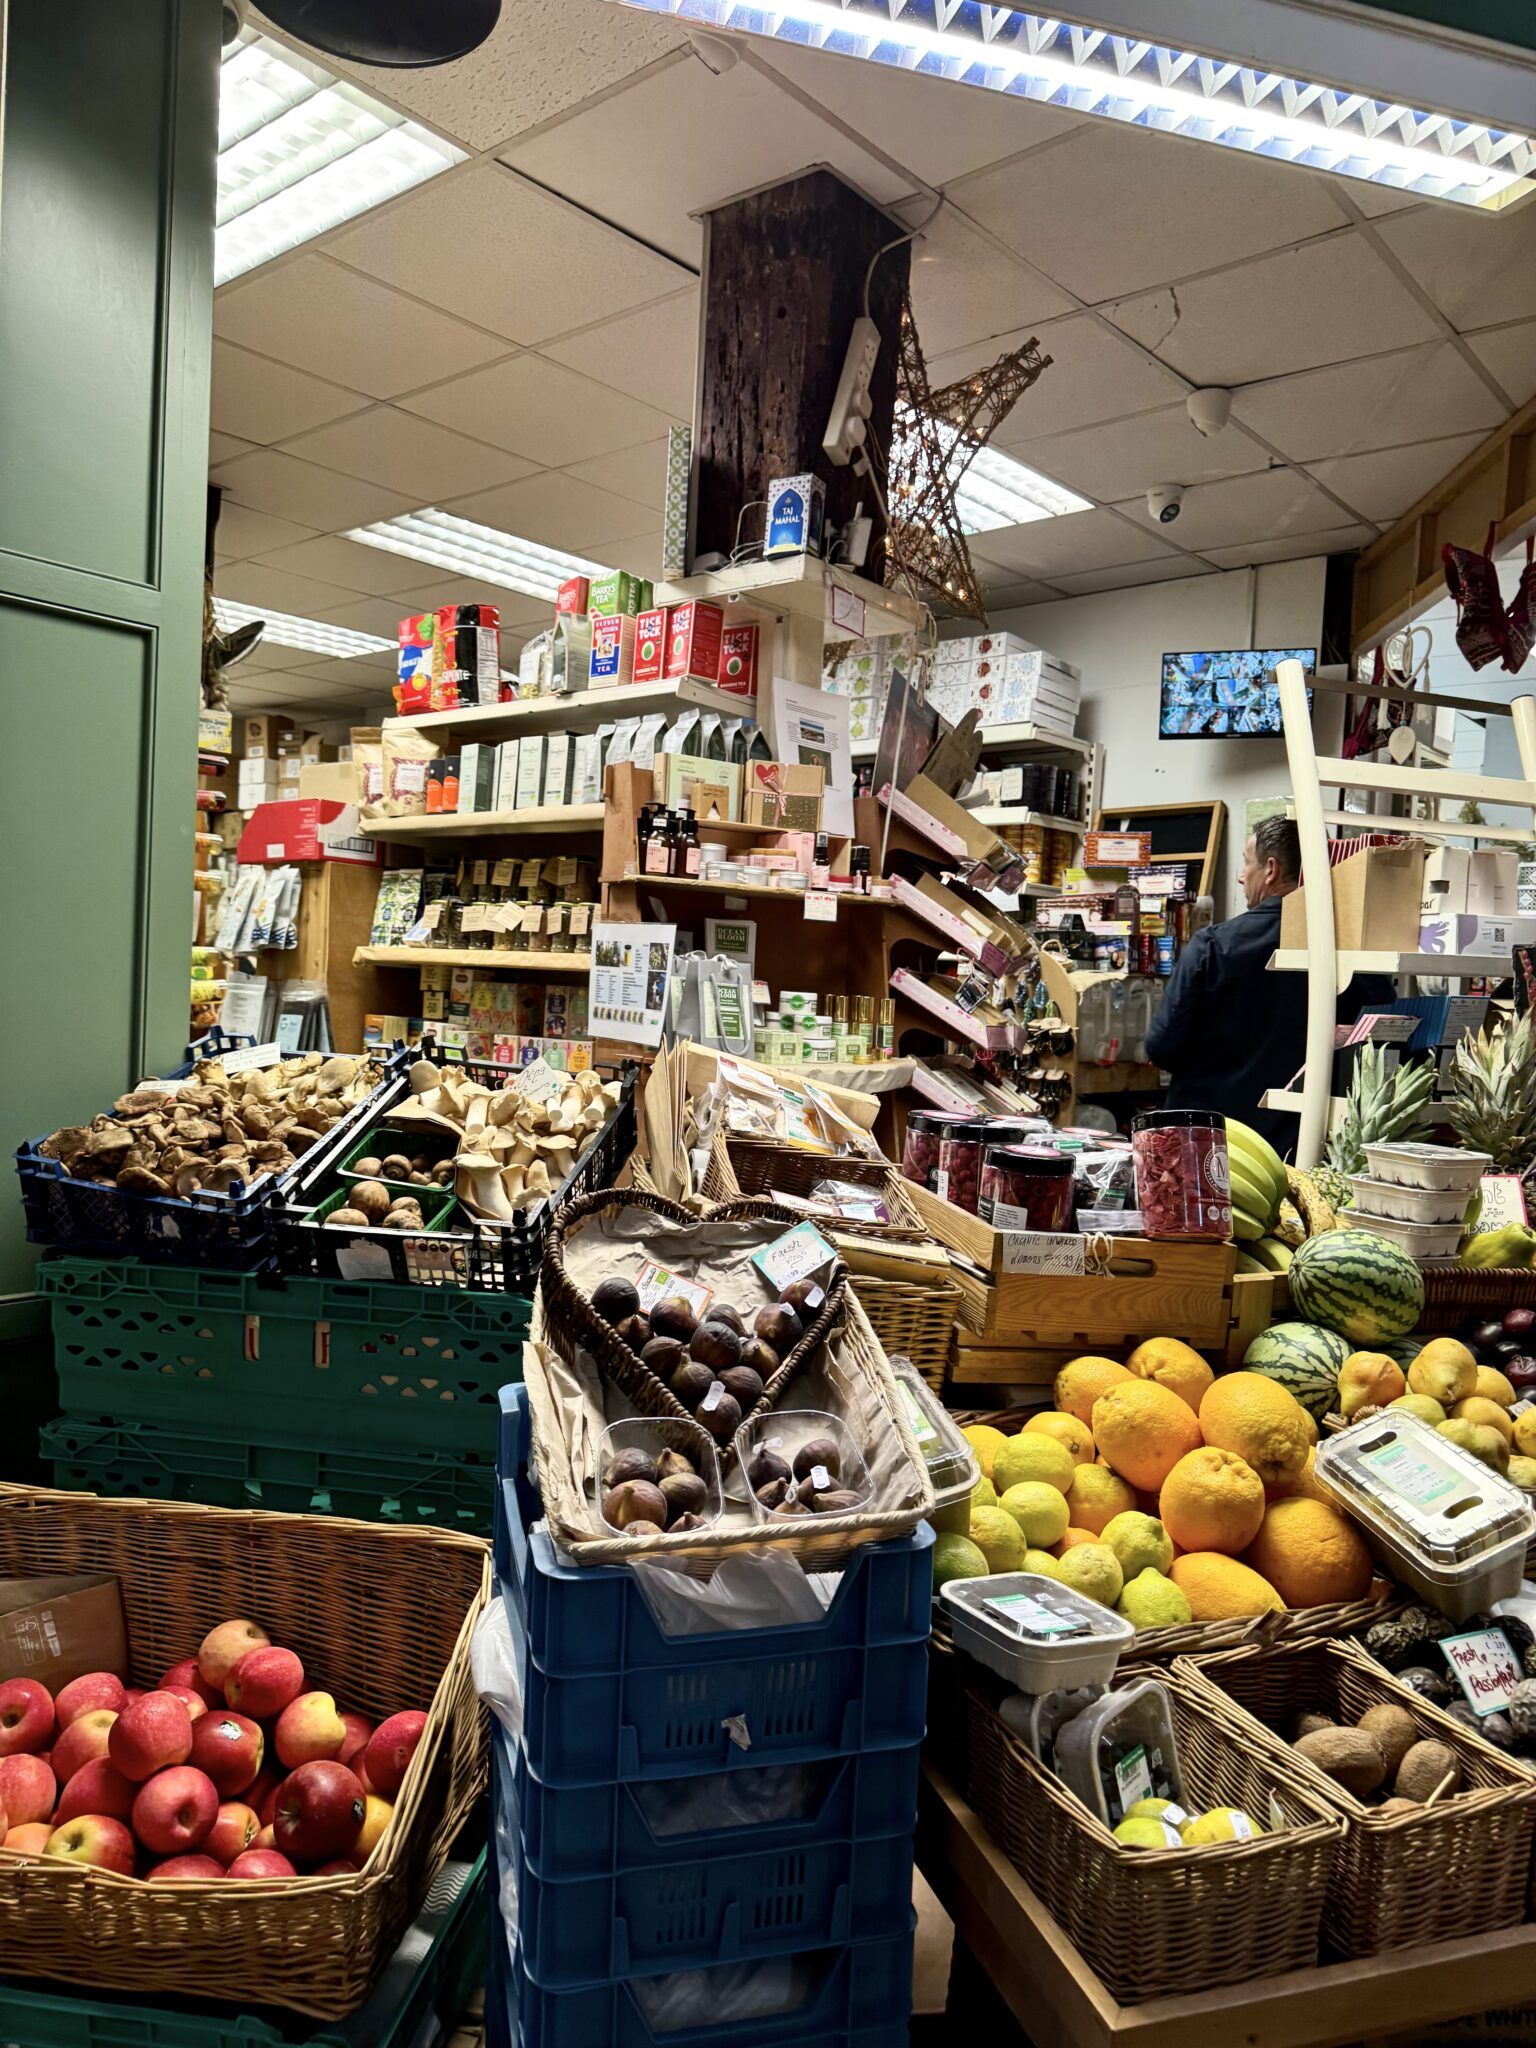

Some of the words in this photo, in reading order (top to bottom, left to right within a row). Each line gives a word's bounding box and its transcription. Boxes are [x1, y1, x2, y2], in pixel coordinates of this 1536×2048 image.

[782, 506, 793, 515] TAJ
[775, 514, 800, 525] MAHAL
[596, 594, 608, 604] TEA
[673, 607, 691, 623] TICK
[639, 615, 662, 628] TICK
[672, 620, 689, 634] TOCK
[639, 626, 661, 640] TOCK
[724, 632, 749, 644] TICK
[723, 643, 749, 655] TOCK
[717, 927, 745, 935] OCEAN
[717, 933, 745, 941] BLOOM
